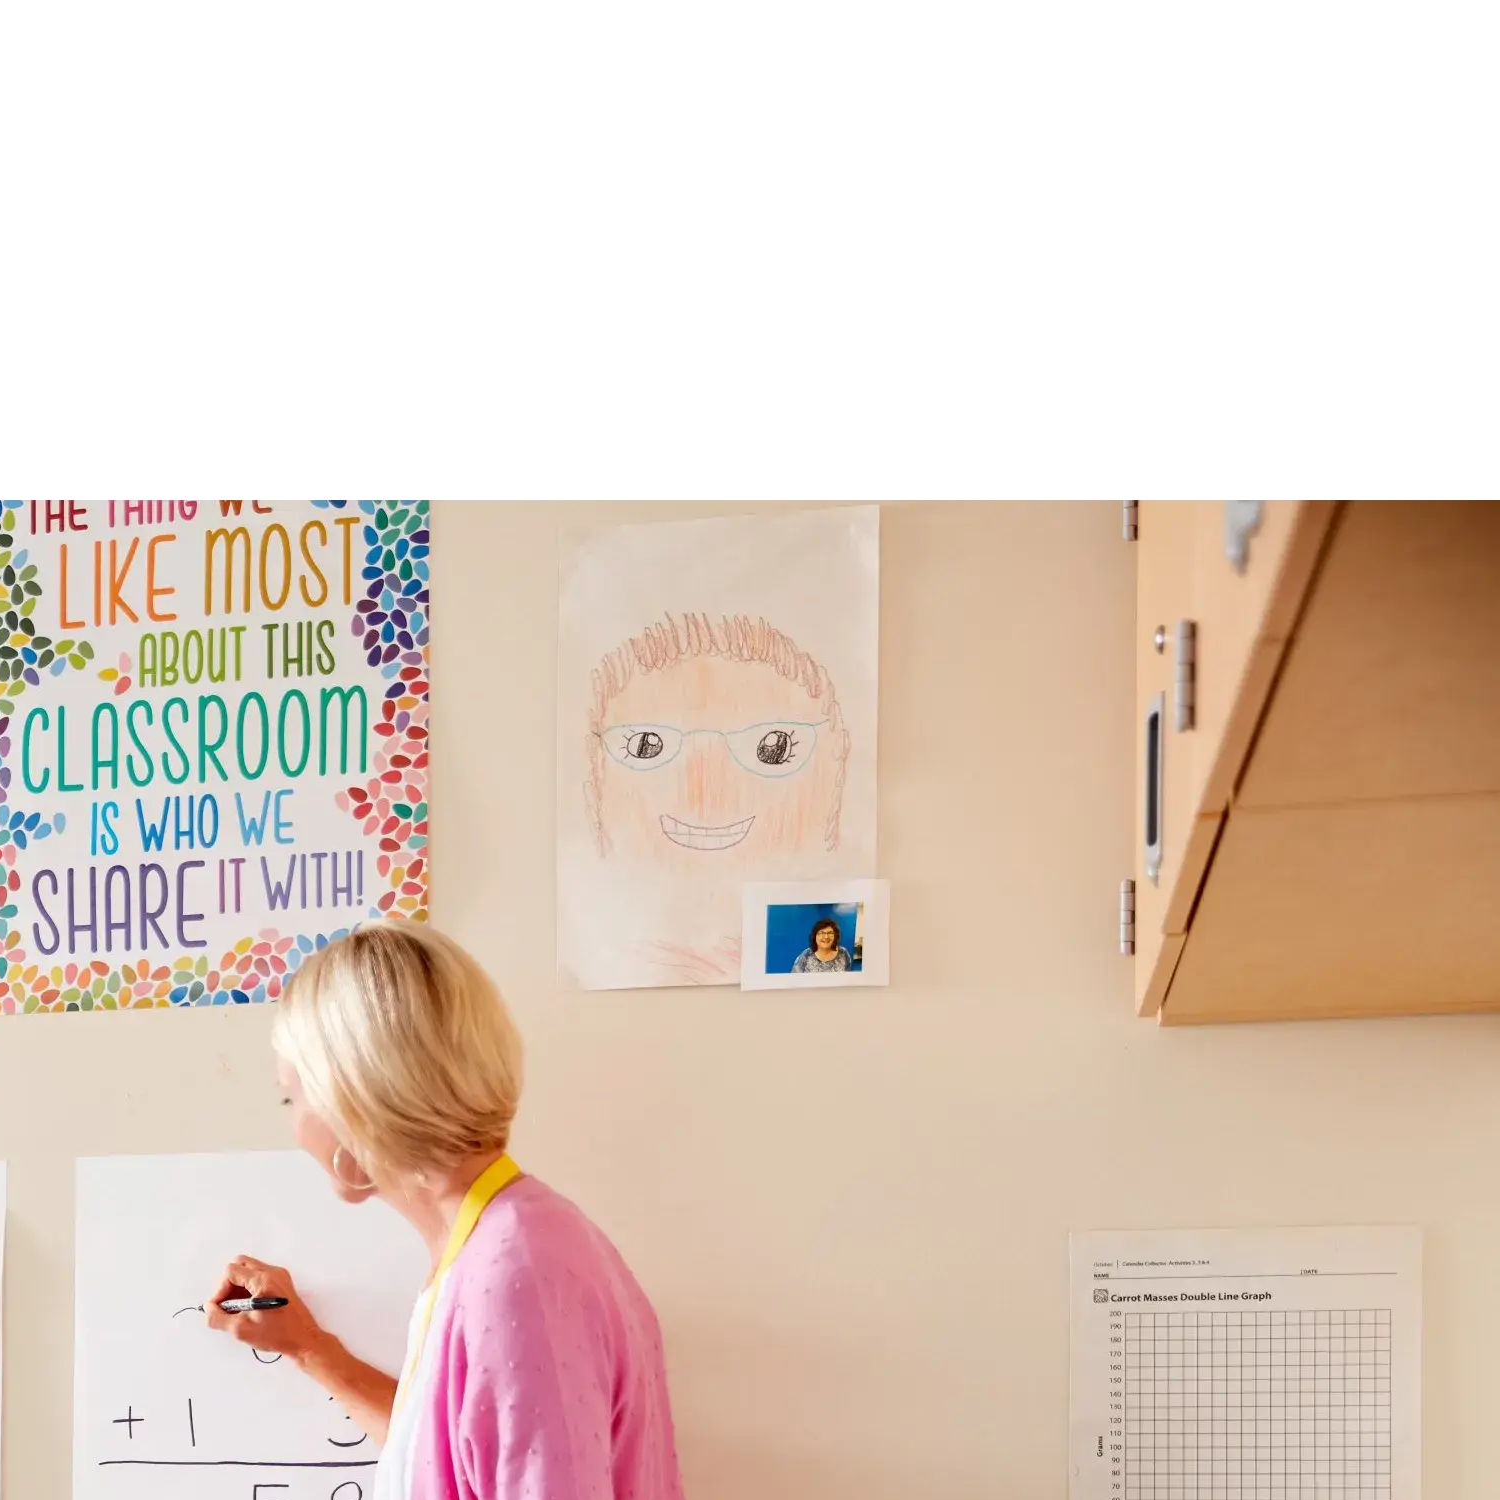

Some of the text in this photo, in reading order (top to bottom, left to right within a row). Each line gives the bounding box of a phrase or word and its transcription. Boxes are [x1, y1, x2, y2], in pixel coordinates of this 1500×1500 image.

[59, 516, 361, 629] LIKE MOST
[139, 620, 336, 687] ABOUT THIS
[22, 685, 368, 794] CLASSROOM
[90, 789, 294, 856] IS WHO WE
[32, 850, 363, 955] SHARE IT WITH!
[1110, 1291, 1272, 1303] Carrot Masses Double Line Graph
